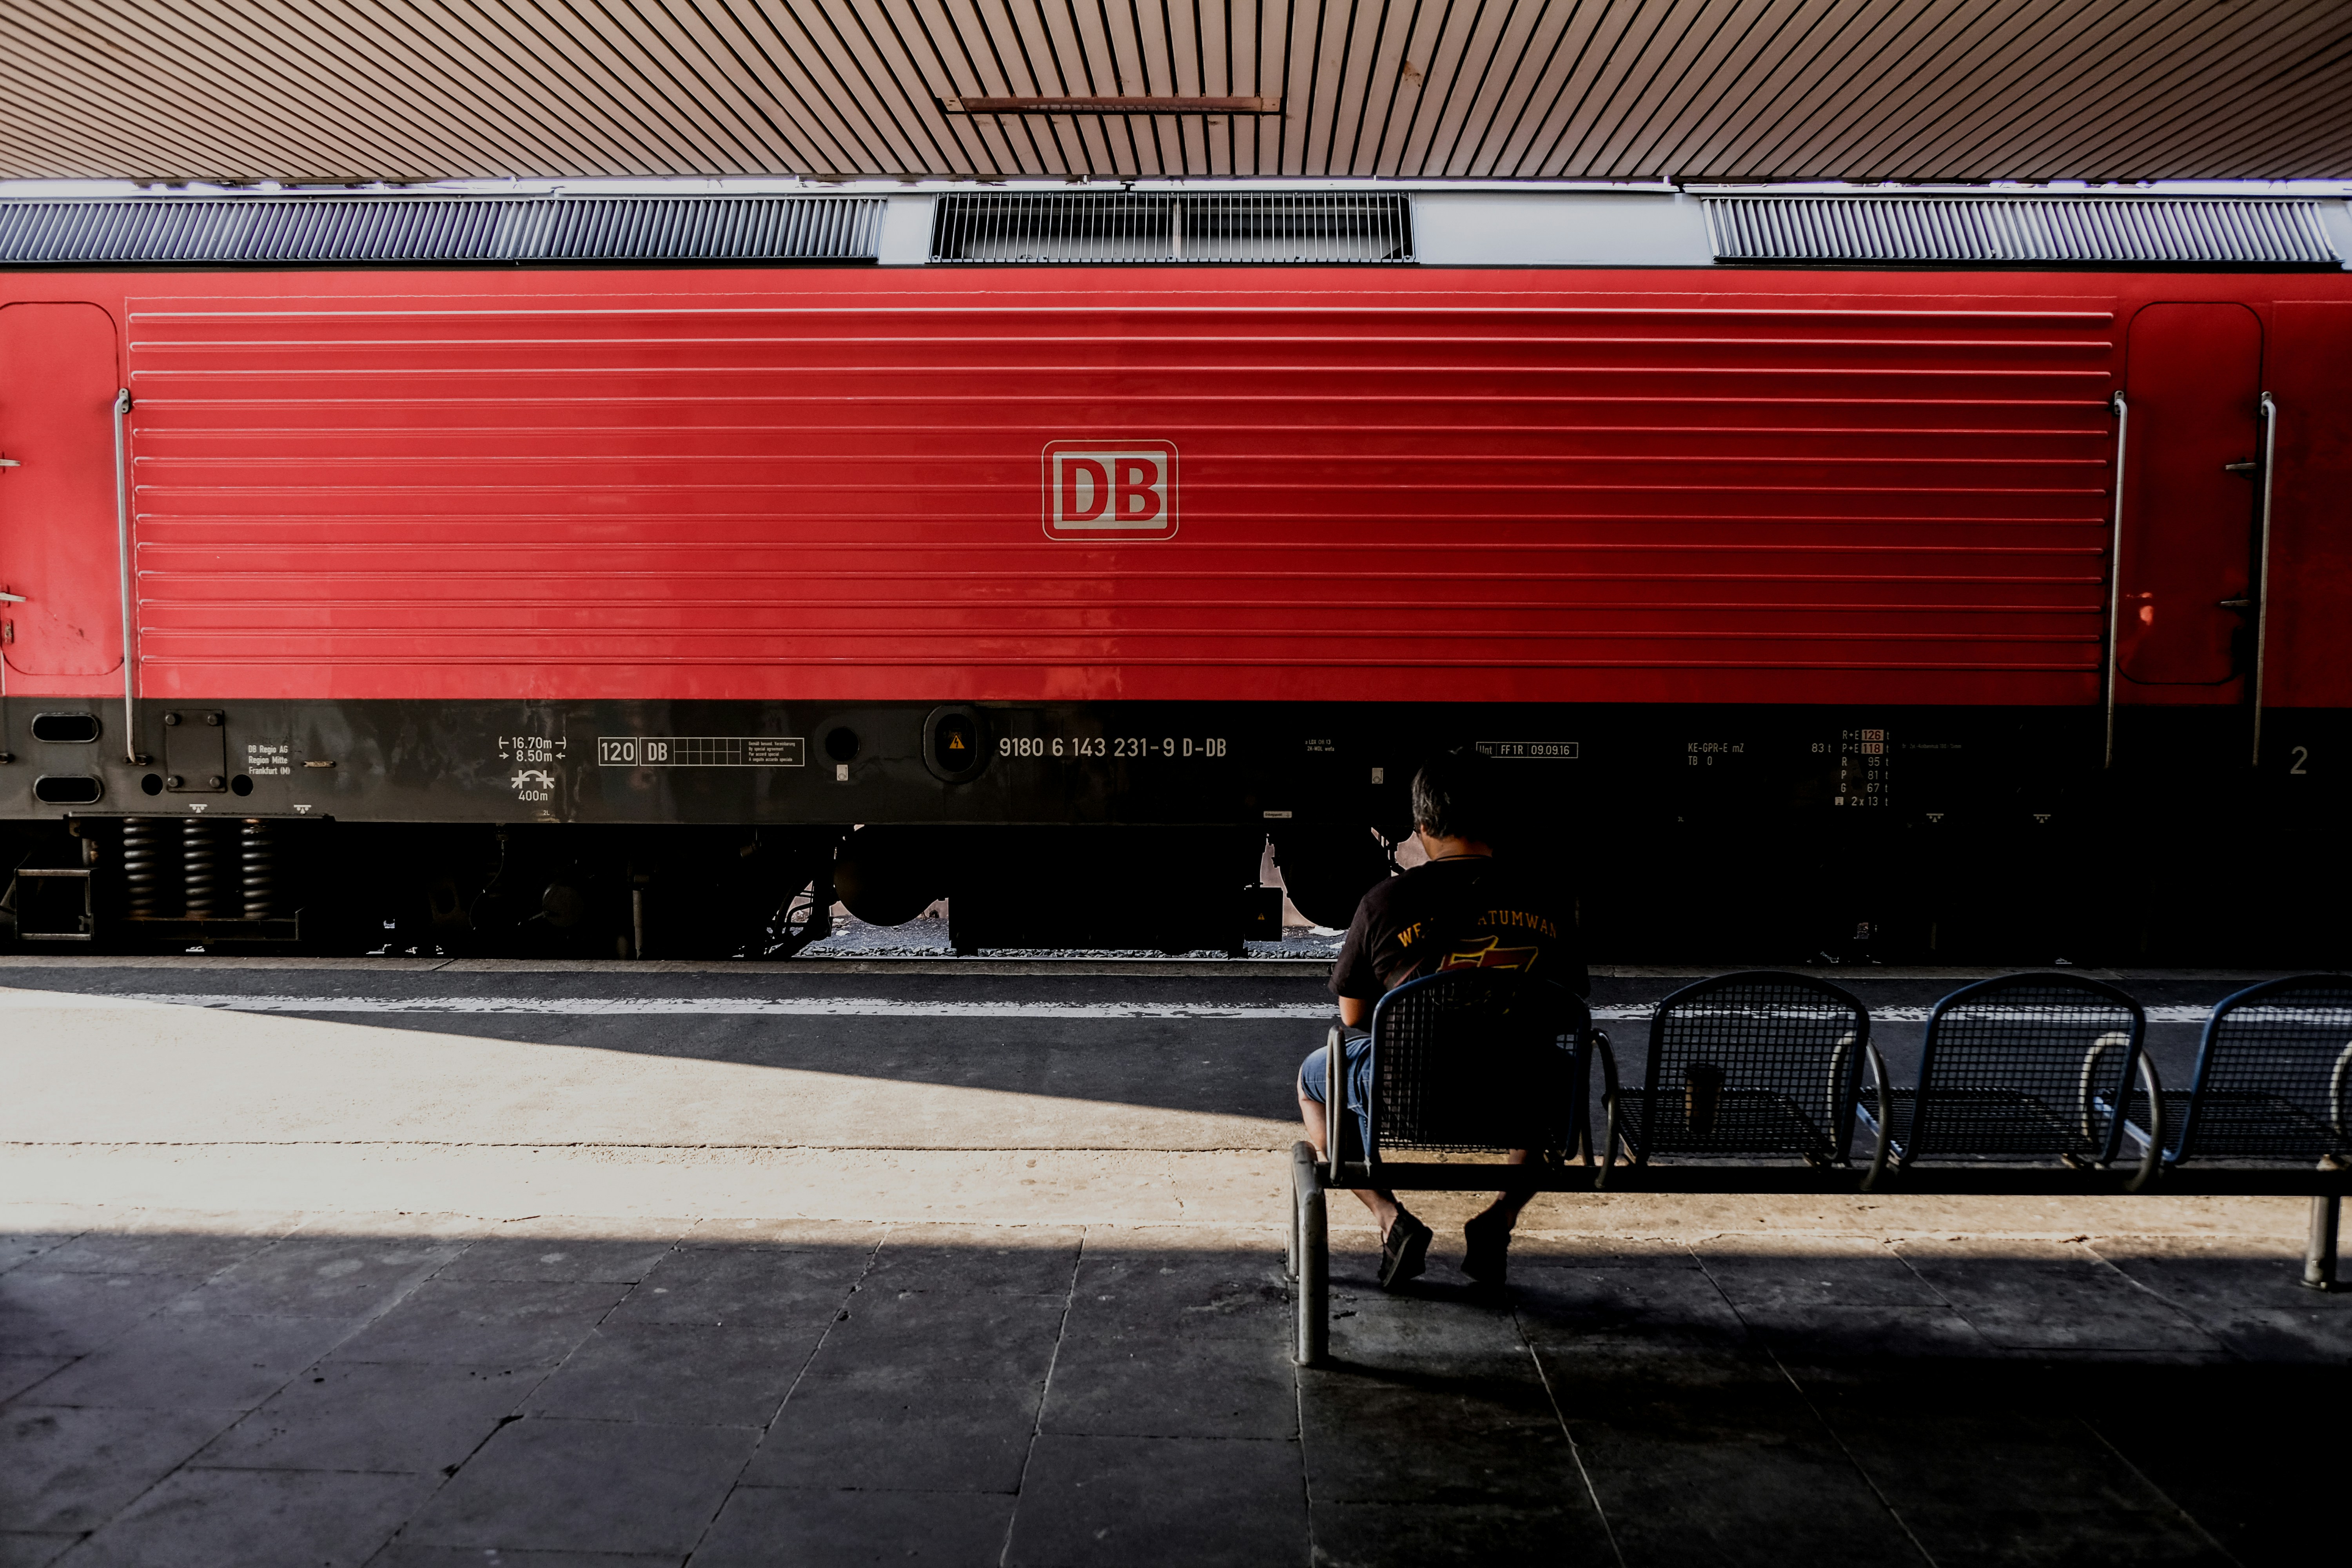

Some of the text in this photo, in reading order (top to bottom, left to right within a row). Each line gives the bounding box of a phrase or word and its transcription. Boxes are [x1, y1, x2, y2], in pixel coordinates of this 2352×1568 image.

[1062, 458, 1160, 521] DB
[1864, 731, 1880, 740] 126
[1887, 731, 1889, 740] t
[512, 737, 552, 749] 16.70m
[1000, 738, 1043, 757] 9180
[1052, 738, 1063, 757] 6
[1073, 738, 1105, 757] 143
[1183, 738, 1226, 757] D-DB
[1688, 743, 1728, 752] KE-GPR-E
[1812, 743, 1831, 753] 83 t
[248, 745, 257, 753] DB
[259, 745, 277, 755] Regio
[602, 742, 668, 761] 120 DB
[1531, 745, 1570, 755] 09.09.16
[1864, 744, 1880, 753] 118
[1886, 744, 1889, 753] t
[249, 755, 288, 766] Region Mitte
[516, 750, 552, 762] 8.50m
[1688, 756, 1697, 765] TB
[2290, 746, 2307, 774] 2
[1842, 757, 1889, 766] R 95 t
[249, 766, 278, 775] Frankfurt
[1841, 770, 1888, 780] P 81 t
[1841, 783, 1888, 793] G 67 t
[518, 790, 548, 801] 400m
[1868, 797, 1878, 806] 13
[1885, 798, 1888, 806] t
